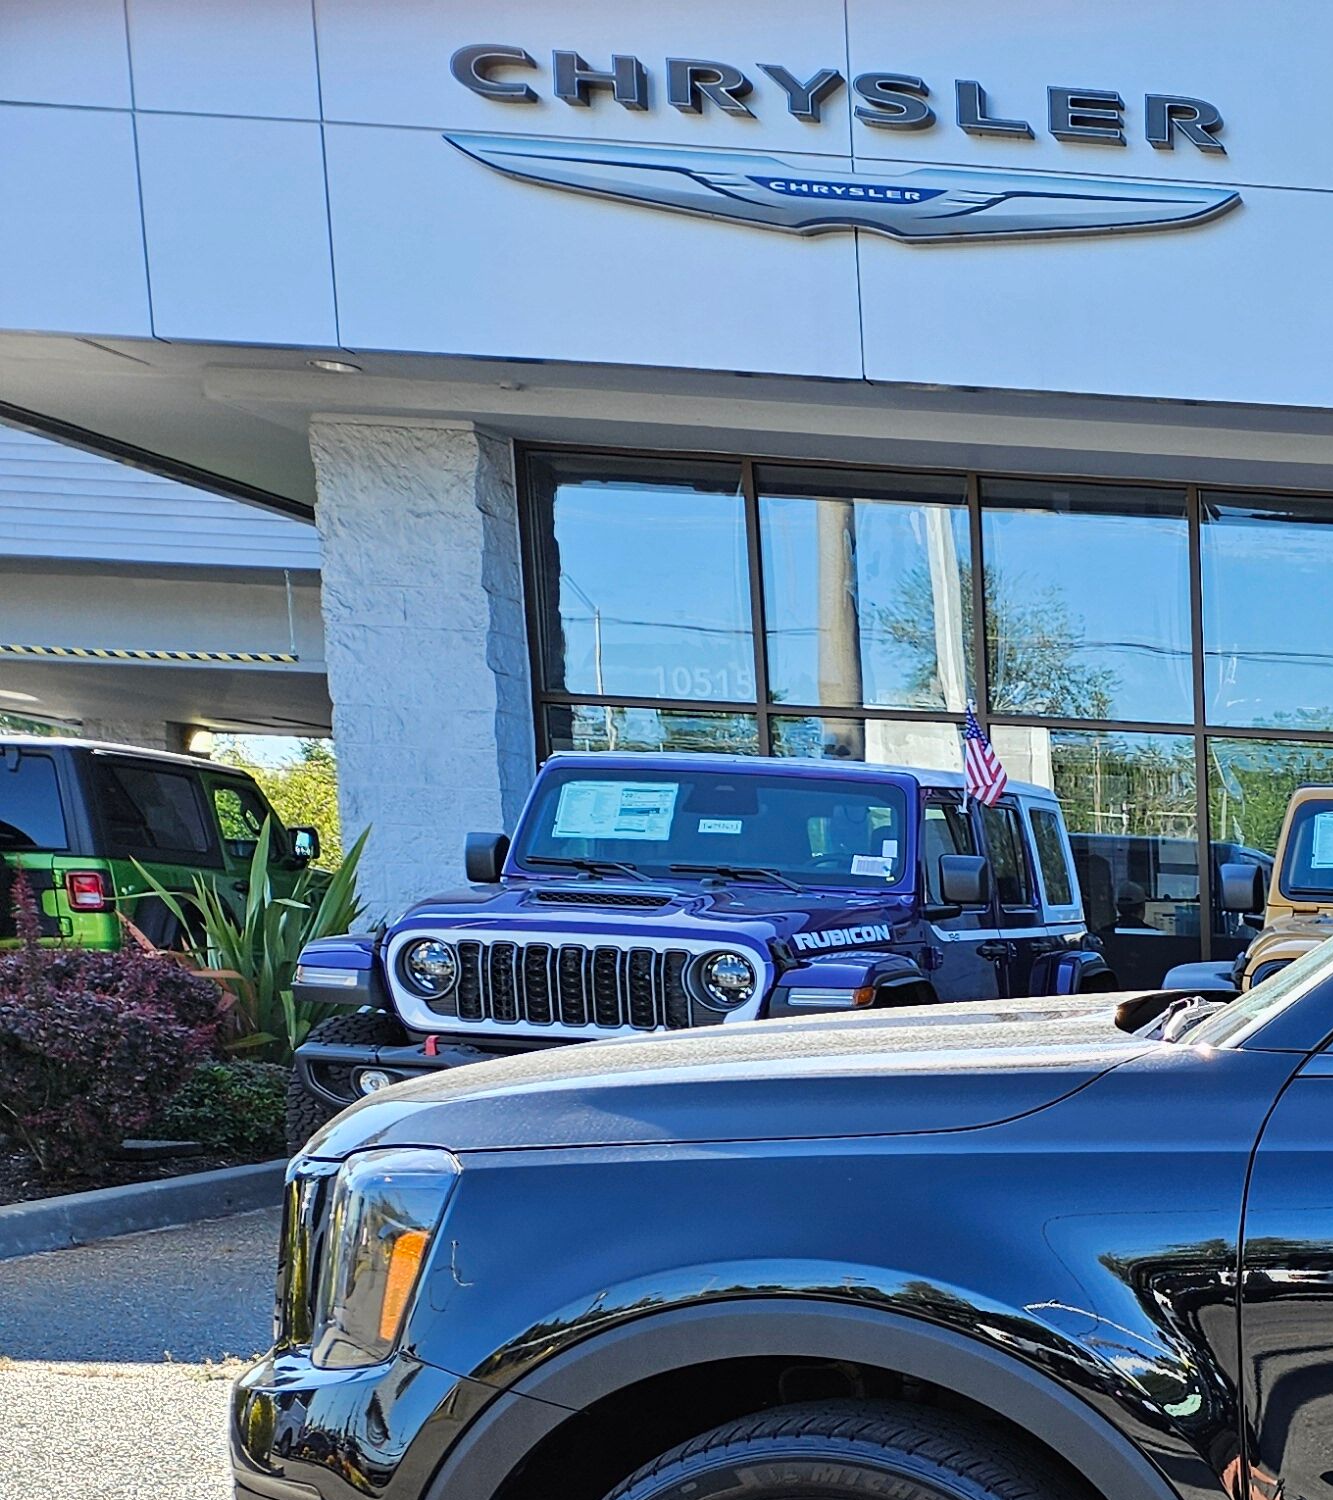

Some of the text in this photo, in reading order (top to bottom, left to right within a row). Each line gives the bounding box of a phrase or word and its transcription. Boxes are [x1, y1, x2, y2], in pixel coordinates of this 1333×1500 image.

[451, 43, 1227, 154] CHRYSLER
[769, 181, 921, 200] CHRYSLER
[655, 664, 752, 699] 10515
[791, 924, 891, 951] RUBICON
